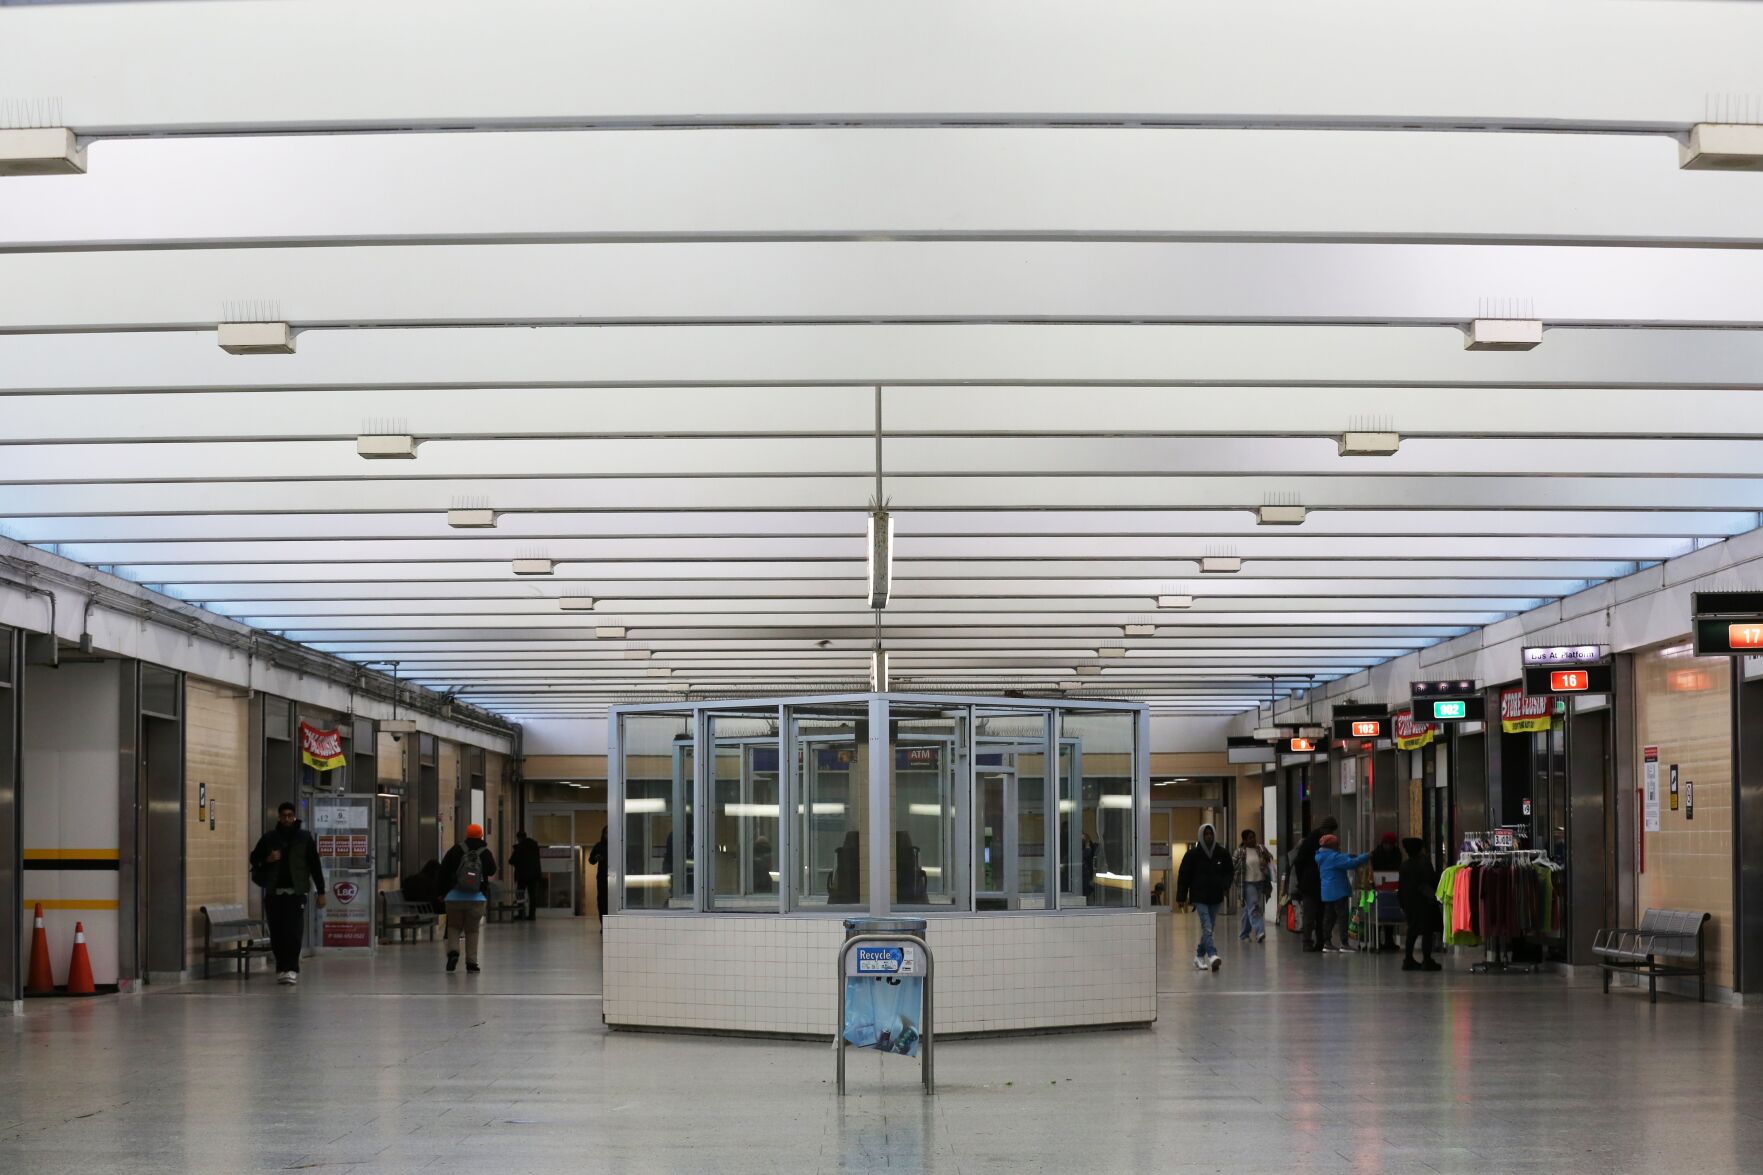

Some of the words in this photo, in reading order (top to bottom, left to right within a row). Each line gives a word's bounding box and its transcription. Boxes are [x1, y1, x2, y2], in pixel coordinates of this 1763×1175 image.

[1743, 628, 1761, 644] 17
[1562, 674, 1577, 687] 16
[1440, 703, 1460, 716] 902
[1357, 724, 1375, 735] 102
[911, 749, 930, 760] ATM
[860, 949, 891, 962] Recycle
